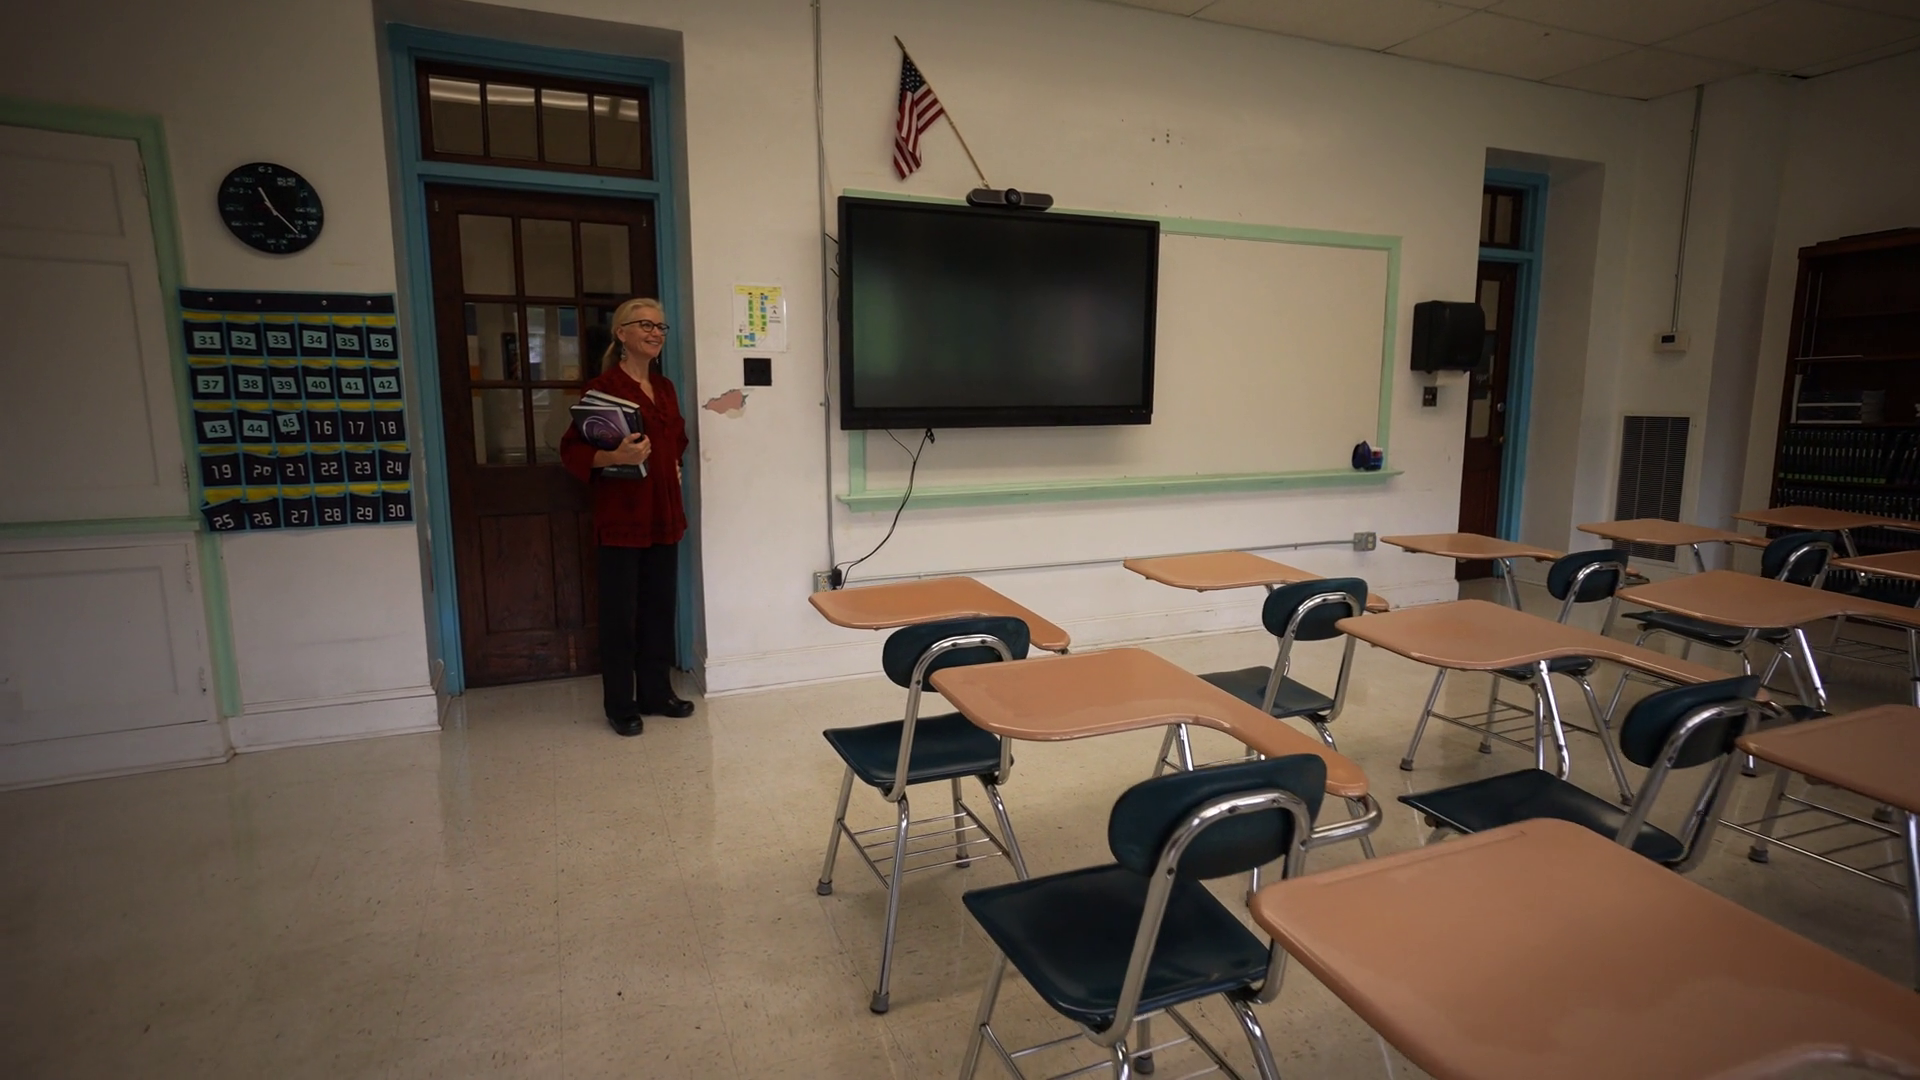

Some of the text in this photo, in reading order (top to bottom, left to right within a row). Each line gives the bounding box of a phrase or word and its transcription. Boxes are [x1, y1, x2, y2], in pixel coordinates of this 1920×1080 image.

[199, 335, 389, 348] 31 32 33 34 35 36
[203, 380, 393, 391] 37 38 39 40 41 42
[210, 418, 397, 435] 43 44 45 16 17 18
[211, 460, 402, 479] 19 20 21 22 23 24
[214, 504, 405, 530] 25 26 27 28 29 30
